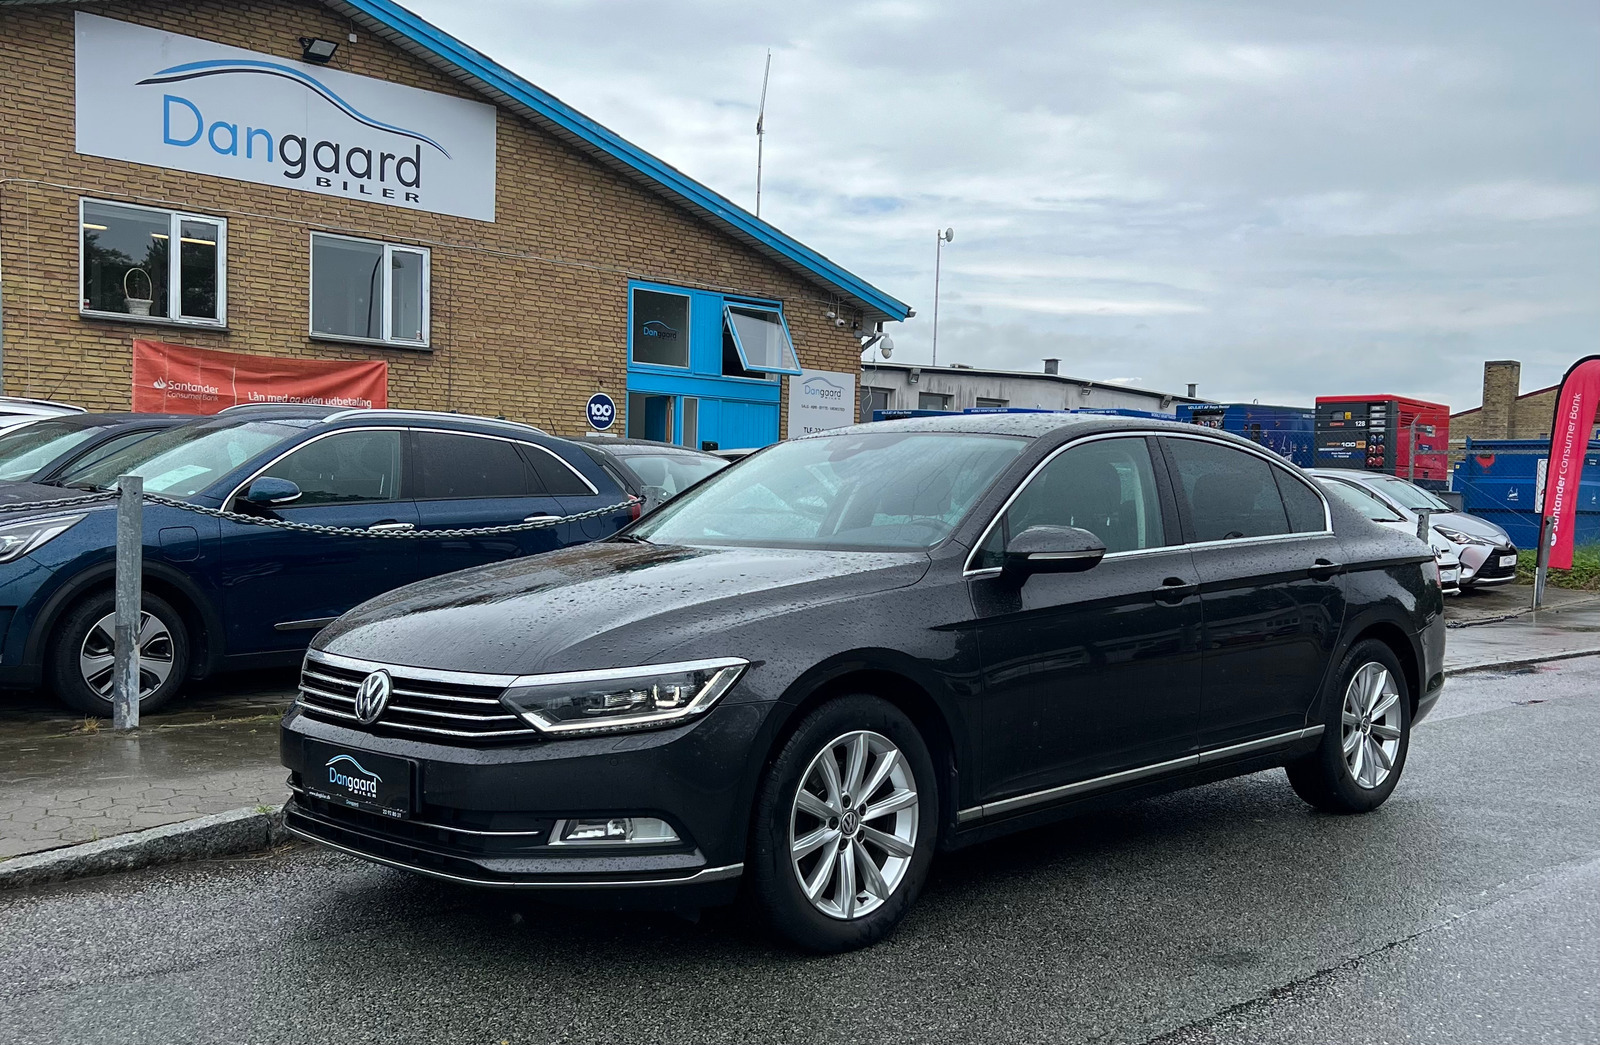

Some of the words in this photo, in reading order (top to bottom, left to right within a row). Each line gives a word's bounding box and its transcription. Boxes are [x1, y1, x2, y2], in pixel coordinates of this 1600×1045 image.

[163, 94, 421, 189] Dangaard
[316, 176, 420, 204] BILER
[167, 390, 201, 400] Consumer
[202, 393, 219, 401] Bank
[168, 380, 219, 394] Santander
[805, 385, 842, 398] Dangaard
[248, 391, 265, 402] Lån
[267, 393, 288, 403] med
[302, 395, 323, 404] uden
[325, 396, 372, 408] udbetaling
[1560, 420, 1576, 475] Consumer
[1569, 392, 1582, 420] Bank
[329, 767, 377, 793] Dangaard
[353, 789, 377, 798] BILER
